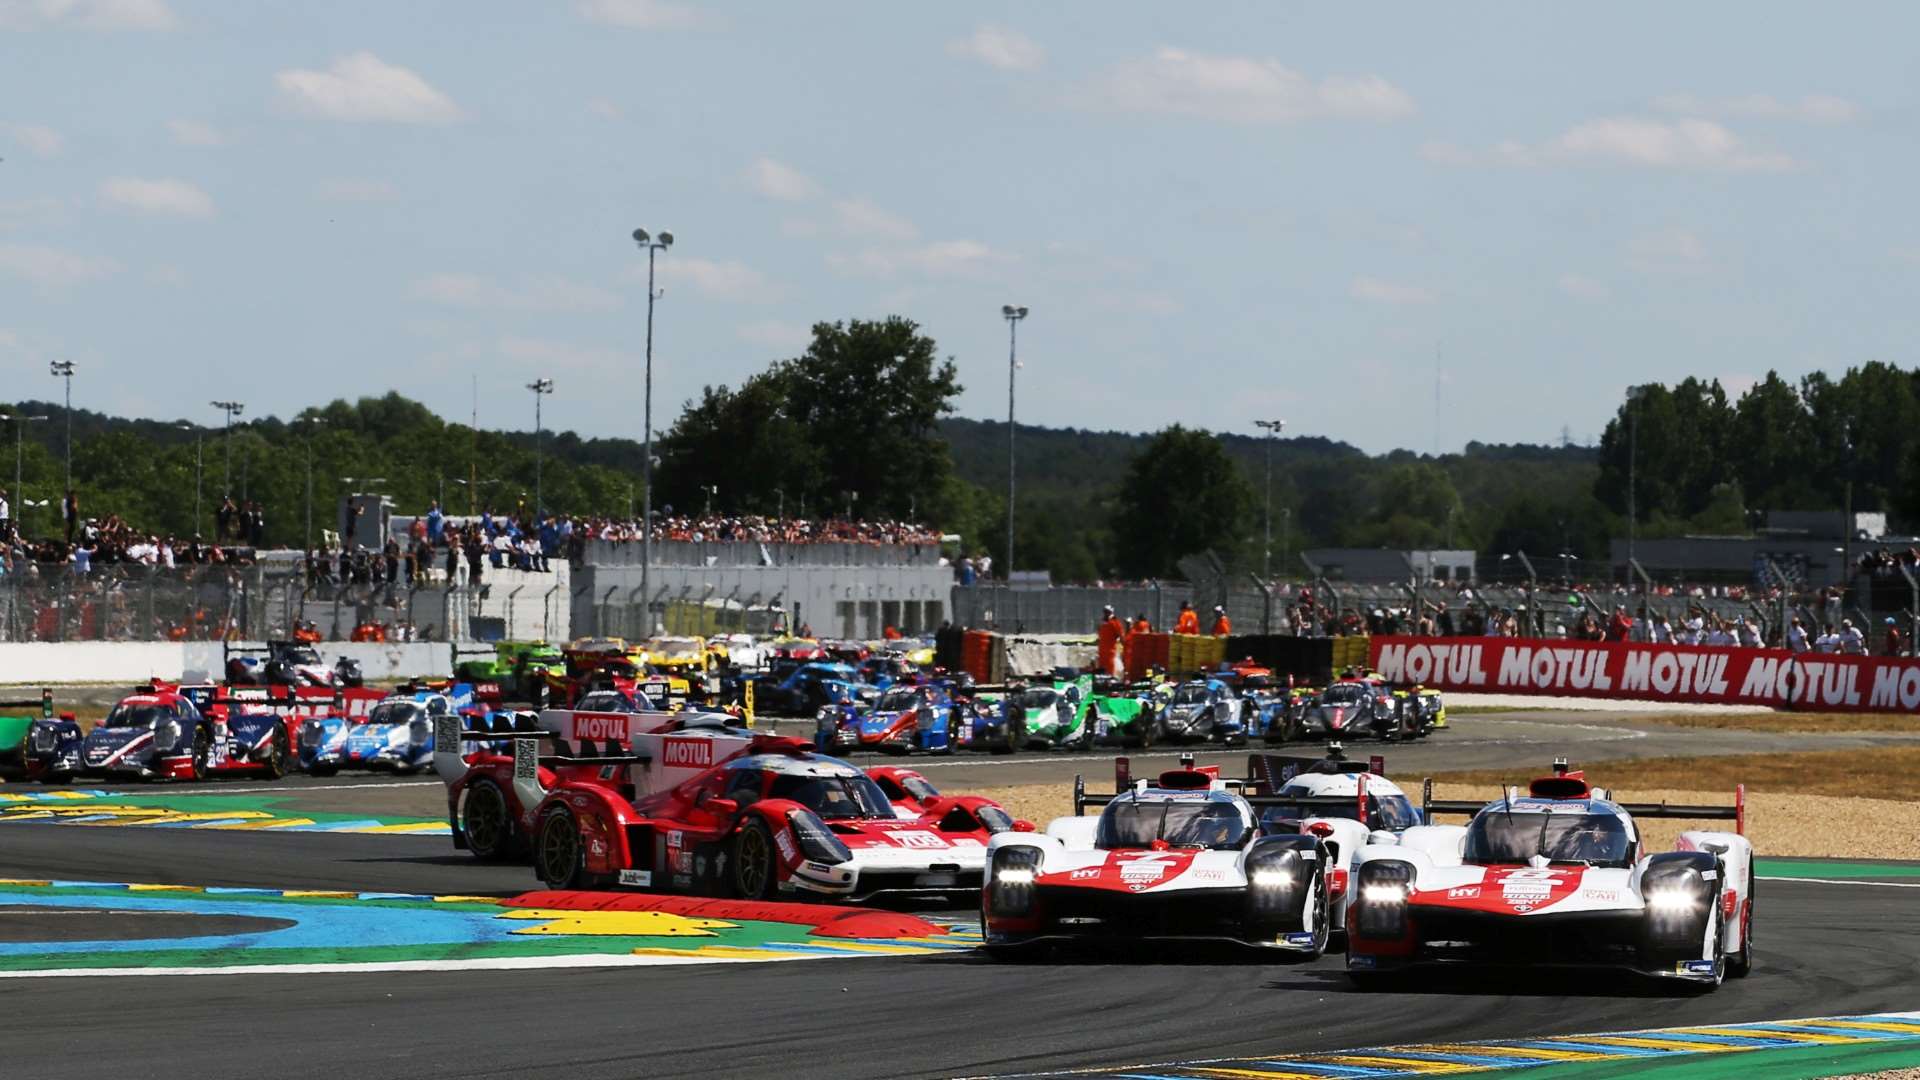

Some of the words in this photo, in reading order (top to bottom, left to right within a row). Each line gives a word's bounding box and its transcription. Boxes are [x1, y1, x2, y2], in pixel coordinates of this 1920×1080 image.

[1376, 643, 1487, 685] MOTUL
[1497, 645, 1612, 691] MOTUL
[1620, 650, 1731, 696] MOTUL
[1739, 656, 1862, 706] MOTUL
[576, 718, 627, 740] MOTUL
[665, 742, 711, 764] MOTUL
[1071, 869, 1099, 879] HY
[1450, 887, 1479, 898] HY
